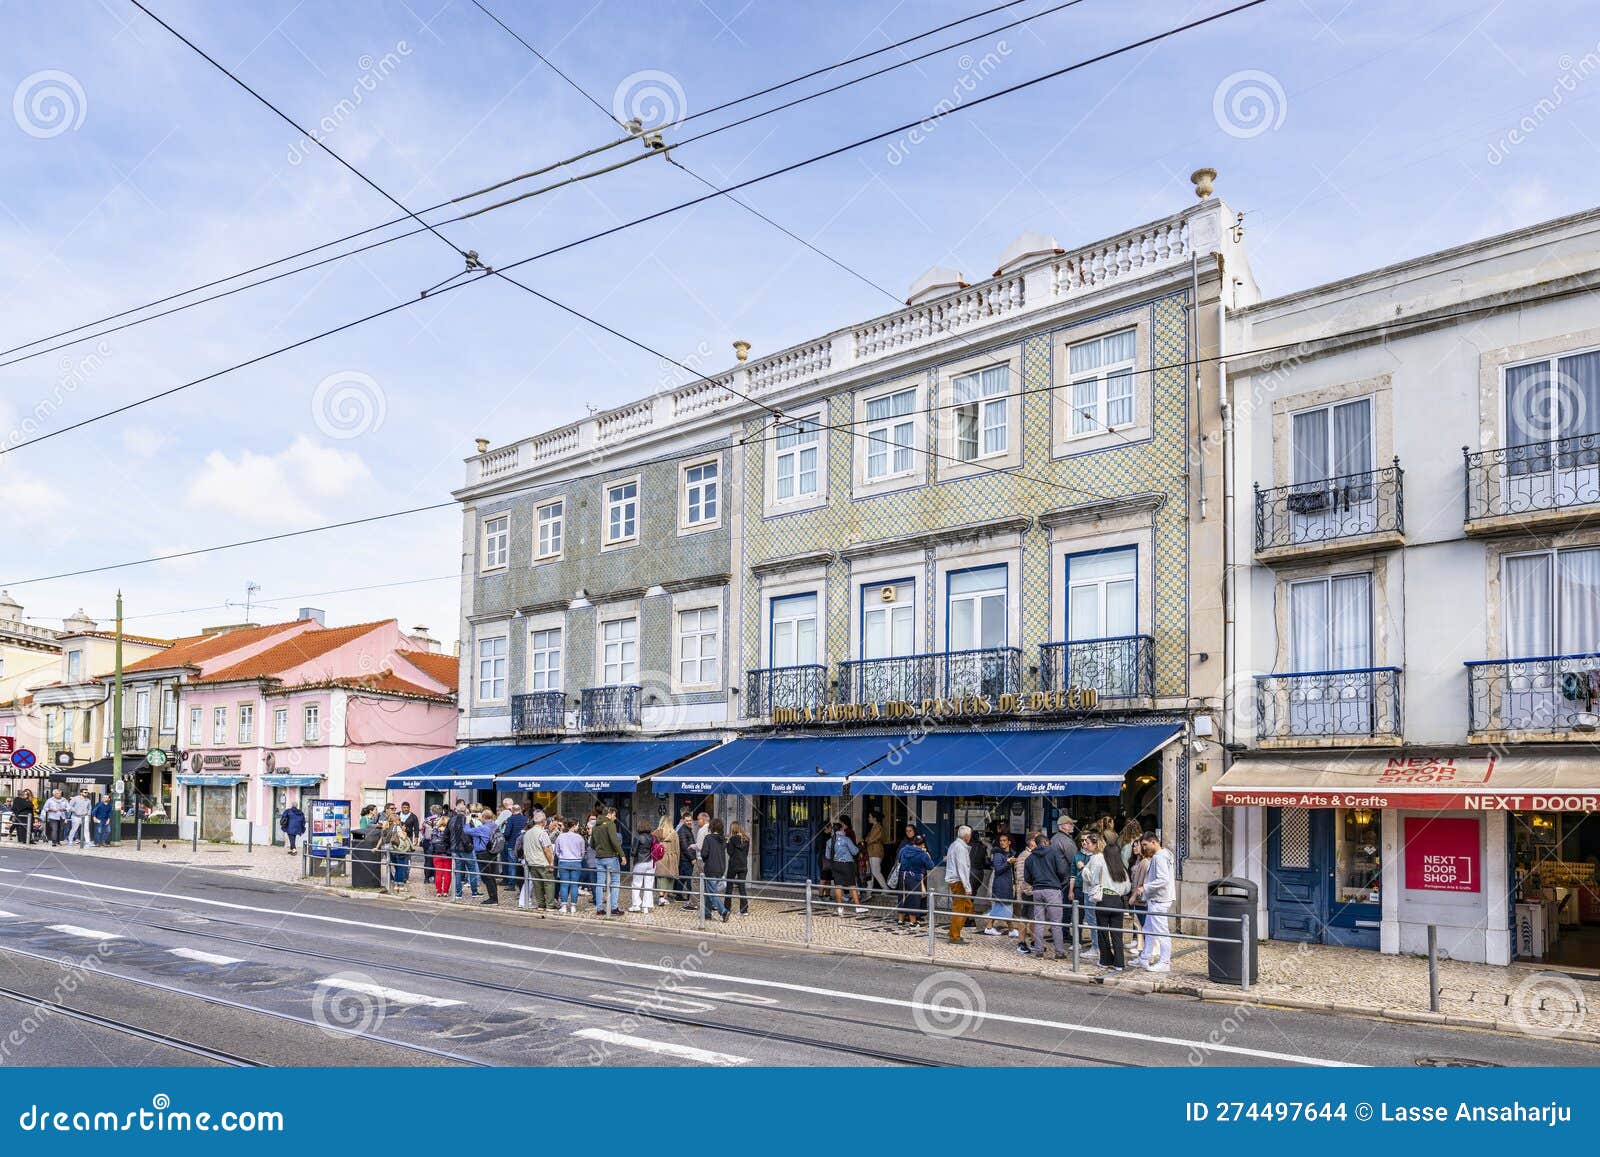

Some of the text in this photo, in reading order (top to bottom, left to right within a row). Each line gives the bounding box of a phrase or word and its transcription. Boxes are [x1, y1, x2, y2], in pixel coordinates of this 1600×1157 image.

[884, 700, 915, 720] DOS
[921, 693, 992, 718] PASTÉIS
[1000, 693, 1024, 714] DE
[1030, 685, 1098, 713] BELÉM
[1388, 757, 1455, 767] NEXT
[1383, 766, 1456, 776] DOOR
[1377, 775, 1454, 783] SHOP
[1225, 794, 1388, 806] Portuguese Arts & Crafts
[1464, 796, 1597, 811] NEXT DOOR
[1424, 855, 1456, 864] NEXT
[1424, 865, 1456, 873] DOOR
[1424, 874, 1456, 883] SHOP
